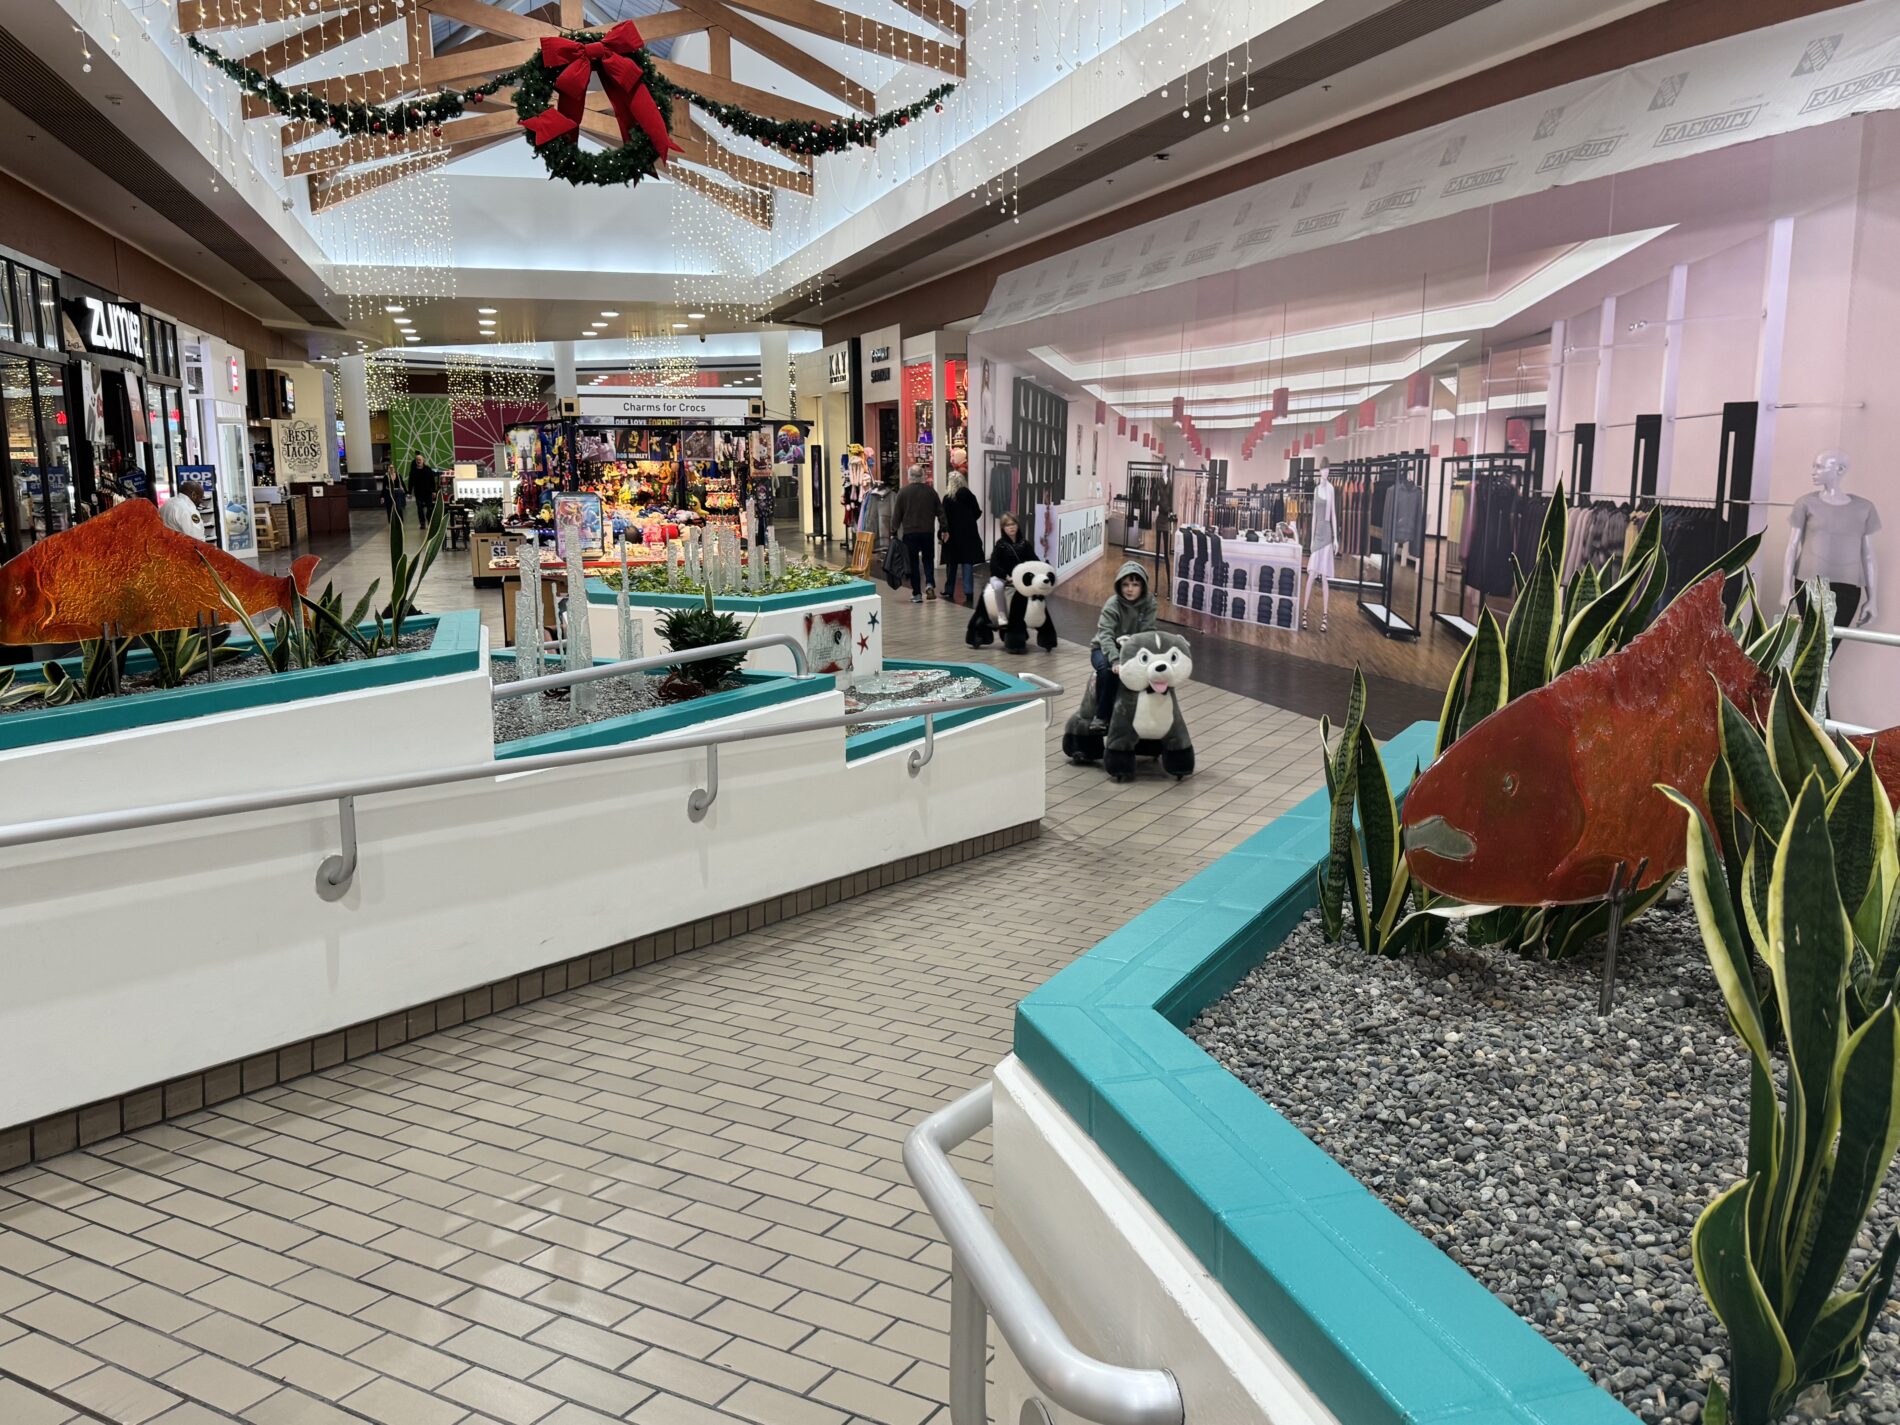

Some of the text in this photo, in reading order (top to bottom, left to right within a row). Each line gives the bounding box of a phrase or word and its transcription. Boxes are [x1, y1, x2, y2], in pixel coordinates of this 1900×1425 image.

[829, 351, 847, 376] KAY
[623, 402, 706, 412] Charms for Crocs
[288, 430, 312, 442] BEST
[284, 443, 318, 458] TACOS
[180, 472, 212, 480] TOP
[493, 547, 507, 557] $5
